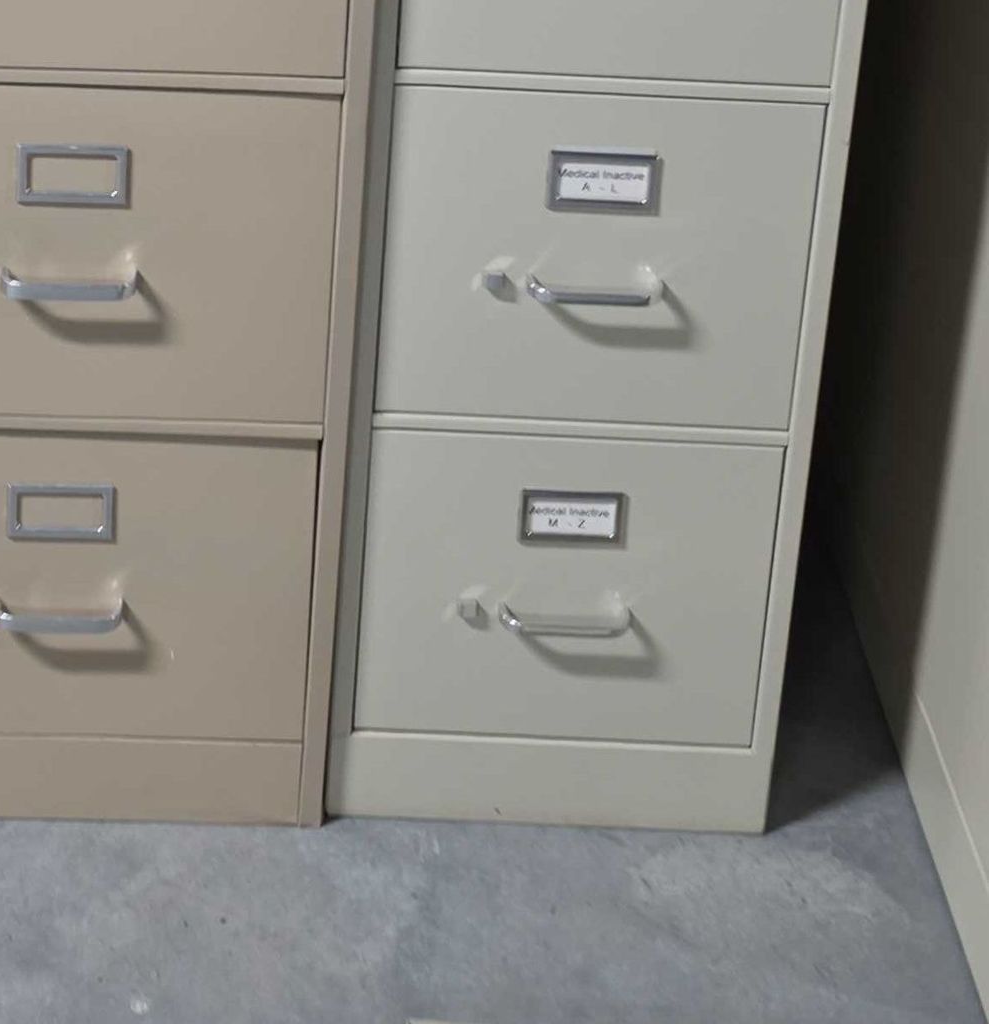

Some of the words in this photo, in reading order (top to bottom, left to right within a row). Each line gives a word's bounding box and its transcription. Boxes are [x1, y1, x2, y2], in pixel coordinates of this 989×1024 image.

[581, 182, 590, 191] A
[611, 184, 618, 193] L
[548, 518, 558, 527] M
[578, 519, 586, 528] Z
